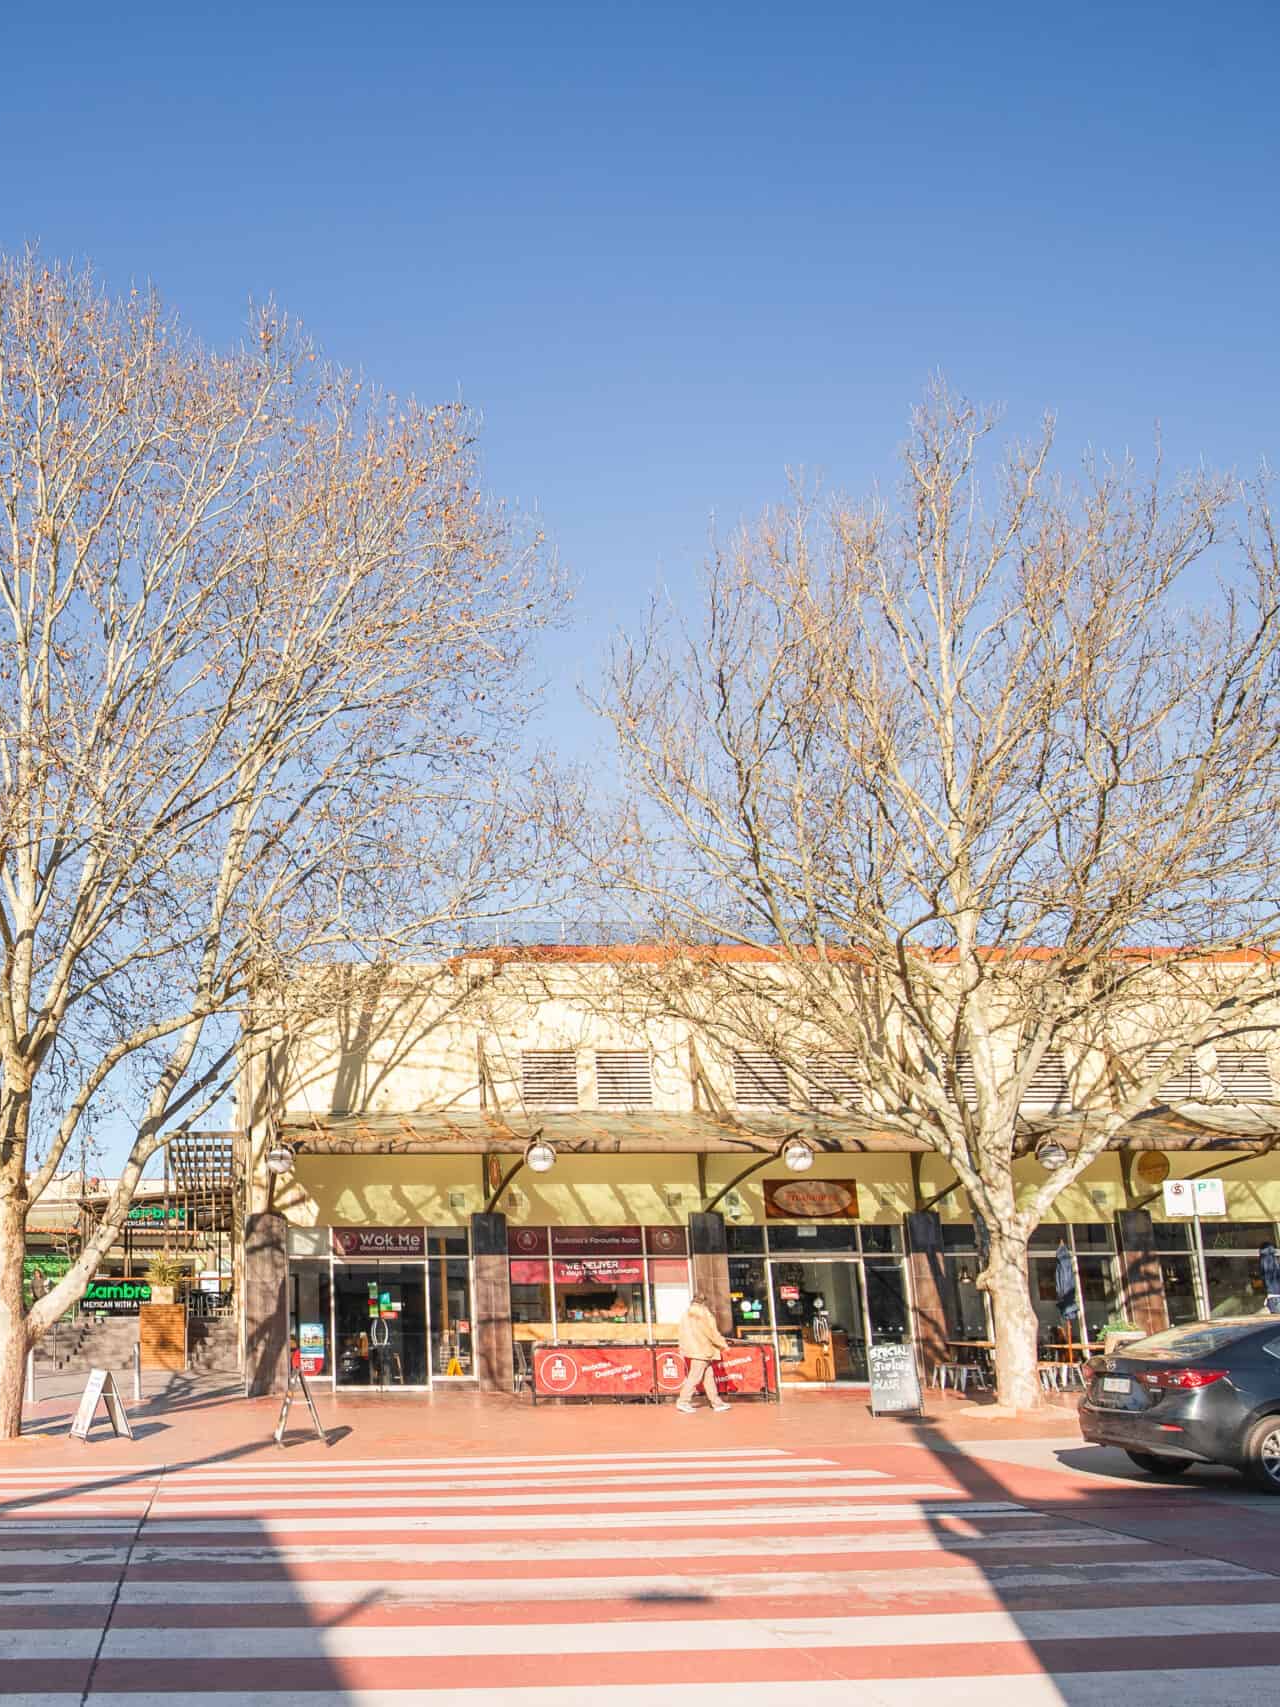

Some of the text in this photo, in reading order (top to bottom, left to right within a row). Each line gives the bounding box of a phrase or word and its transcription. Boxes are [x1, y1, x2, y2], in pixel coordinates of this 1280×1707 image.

[1198, 1183, 1207, 1192] P
[360, 1233, 421, 1246] Wok Me
[565, 1260, 618, 1270] WE DELIVER
